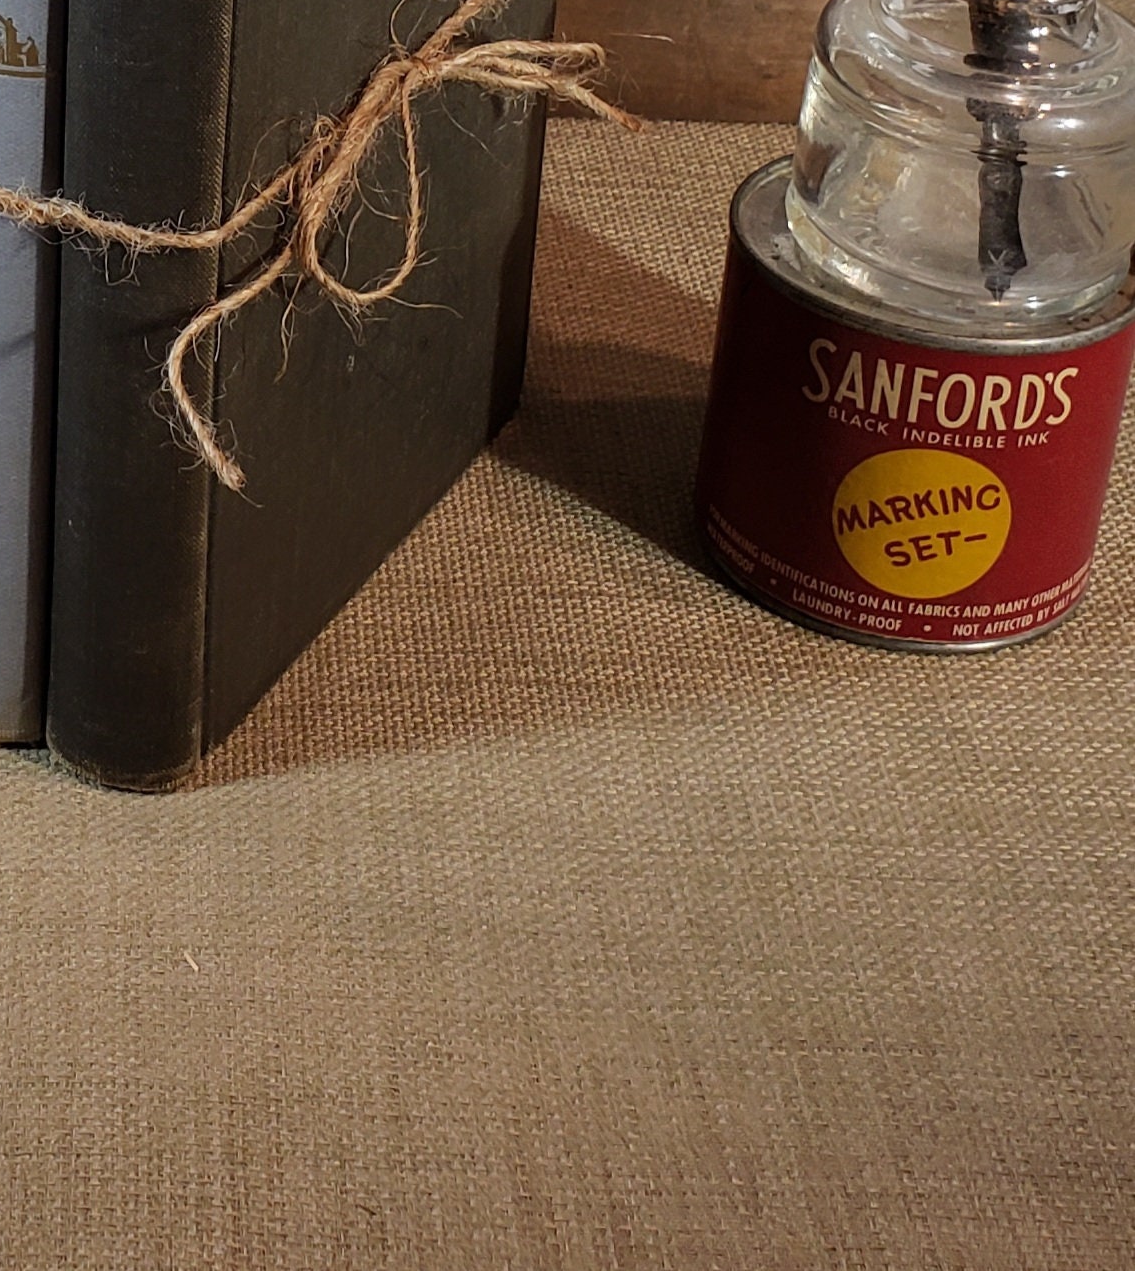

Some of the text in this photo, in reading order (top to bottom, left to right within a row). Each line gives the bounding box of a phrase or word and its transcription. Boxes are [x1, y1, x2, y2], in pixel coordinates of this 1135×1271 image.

[801, 337, 1080, 432] SANFORD'S
[827, 405, 1051, 450] BLACK INDELIBLE INK
[836, 483, 1002, 536] MARKING
[760, 550, 856, 605] IDENTIFICATIONS
[857, 593, 879, 609] ON
[881, 597, 903, 614] ALL
[908, 603, 961, 619] FABRICS
[961, 604, 991, 619] AND
[993, 596, 1031, 617] MANY
[1030, 584, 1061, 607] OTHER
[952, 622, 981, 637] NOT
[983, 615, 1034, 636] AFFECTED
[1036, 606, 1051, 624] BY
